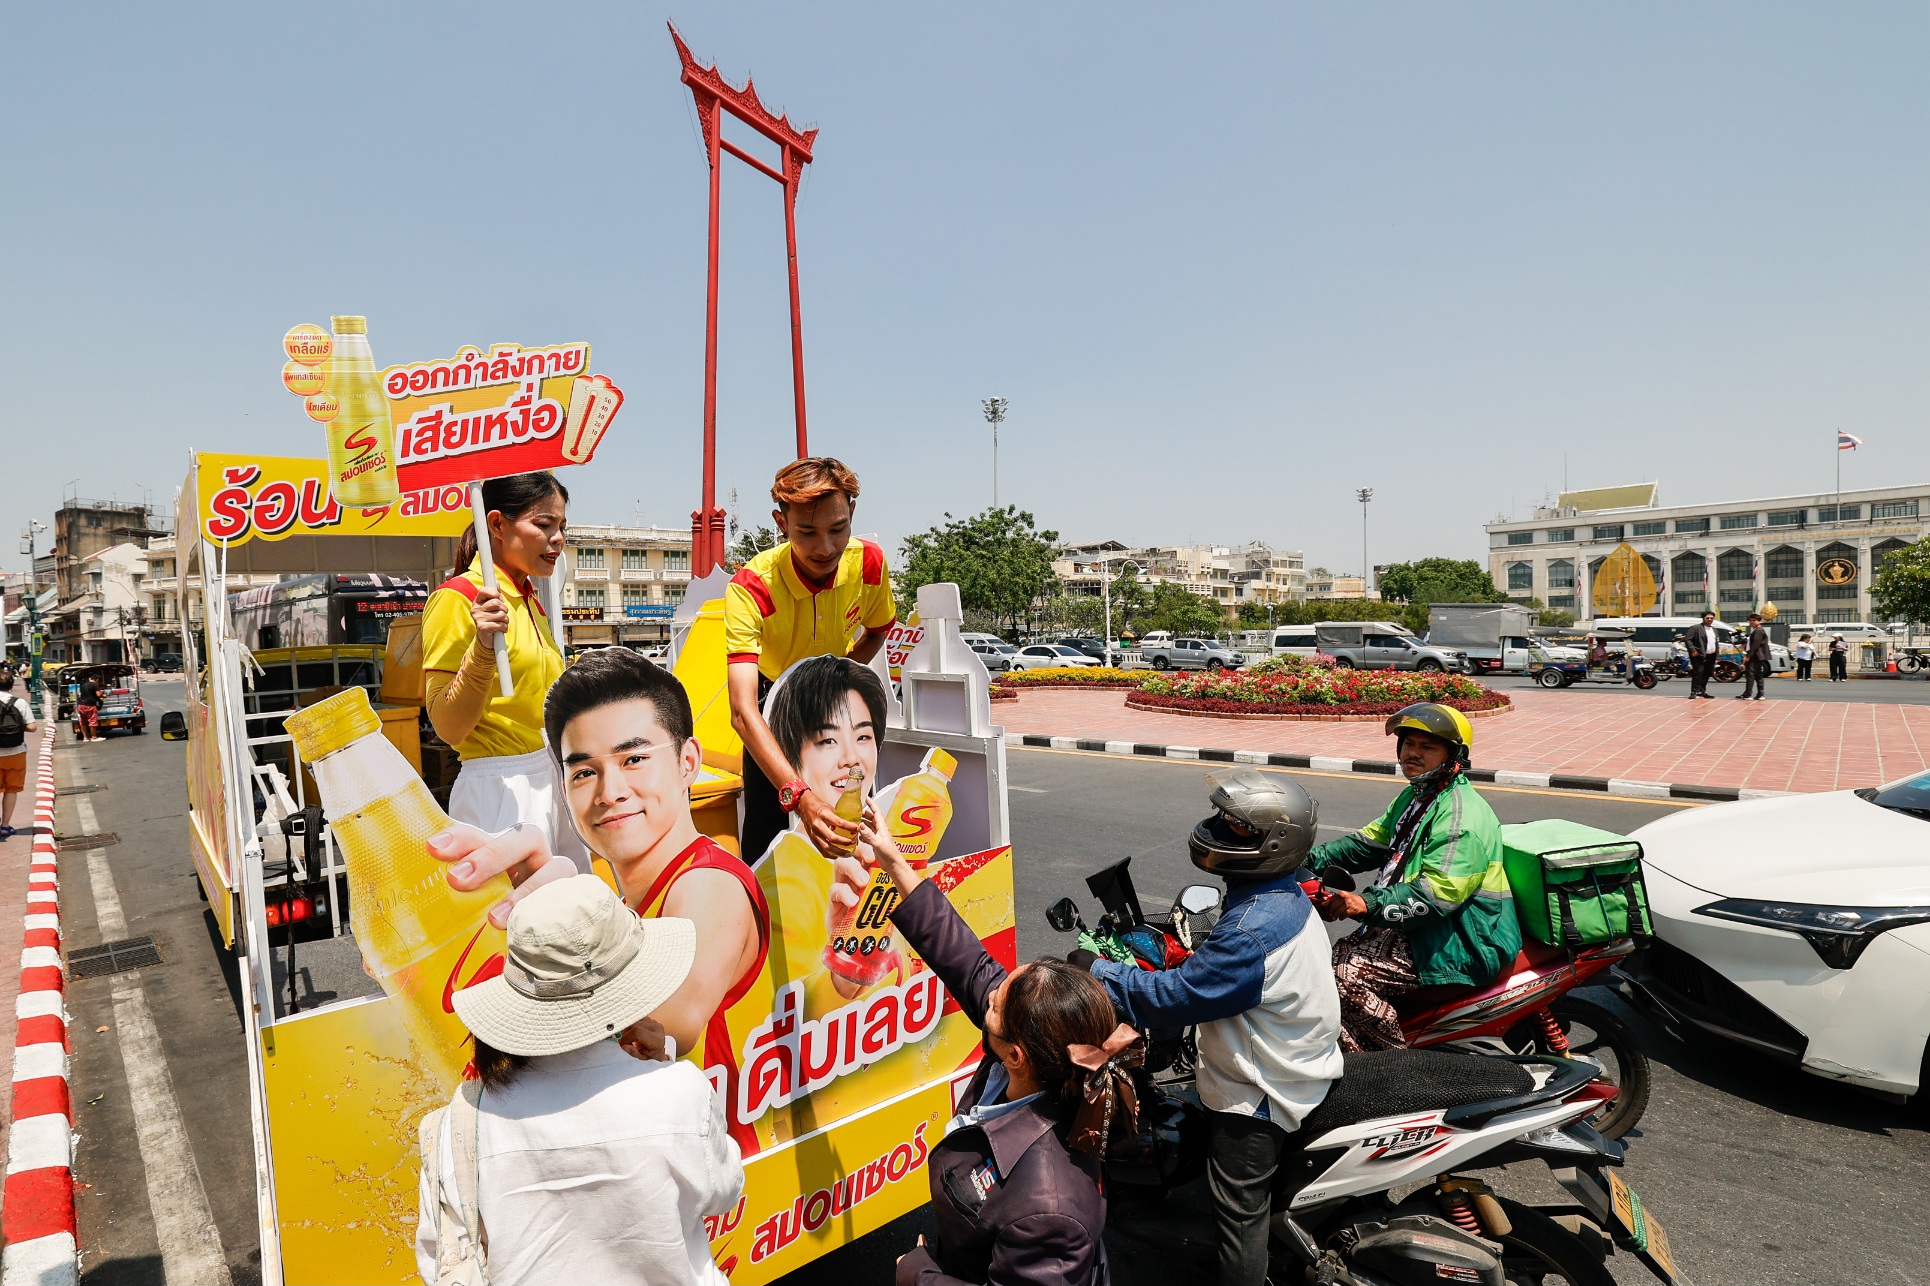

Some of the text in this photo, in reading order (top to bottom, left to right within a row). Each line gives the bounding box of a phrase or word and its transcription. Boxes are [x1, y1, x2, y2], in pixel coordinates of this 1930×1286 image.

[289, 342, 330, 354] เกลือแร่
[387, 349, 581, 395] ออกกำลังกาย
[400, 382, 558, 459] เสียเหงื่อ
[340, 452, 387, 483] สปอนเซอร์
[209, 466, 339, 538] ร้อน
[856, 885, 899, 929] GO
[746, 975, 938, 1114] ดื่มเลย
[751, 1120, 928, 1264] สปอนเซอร์
